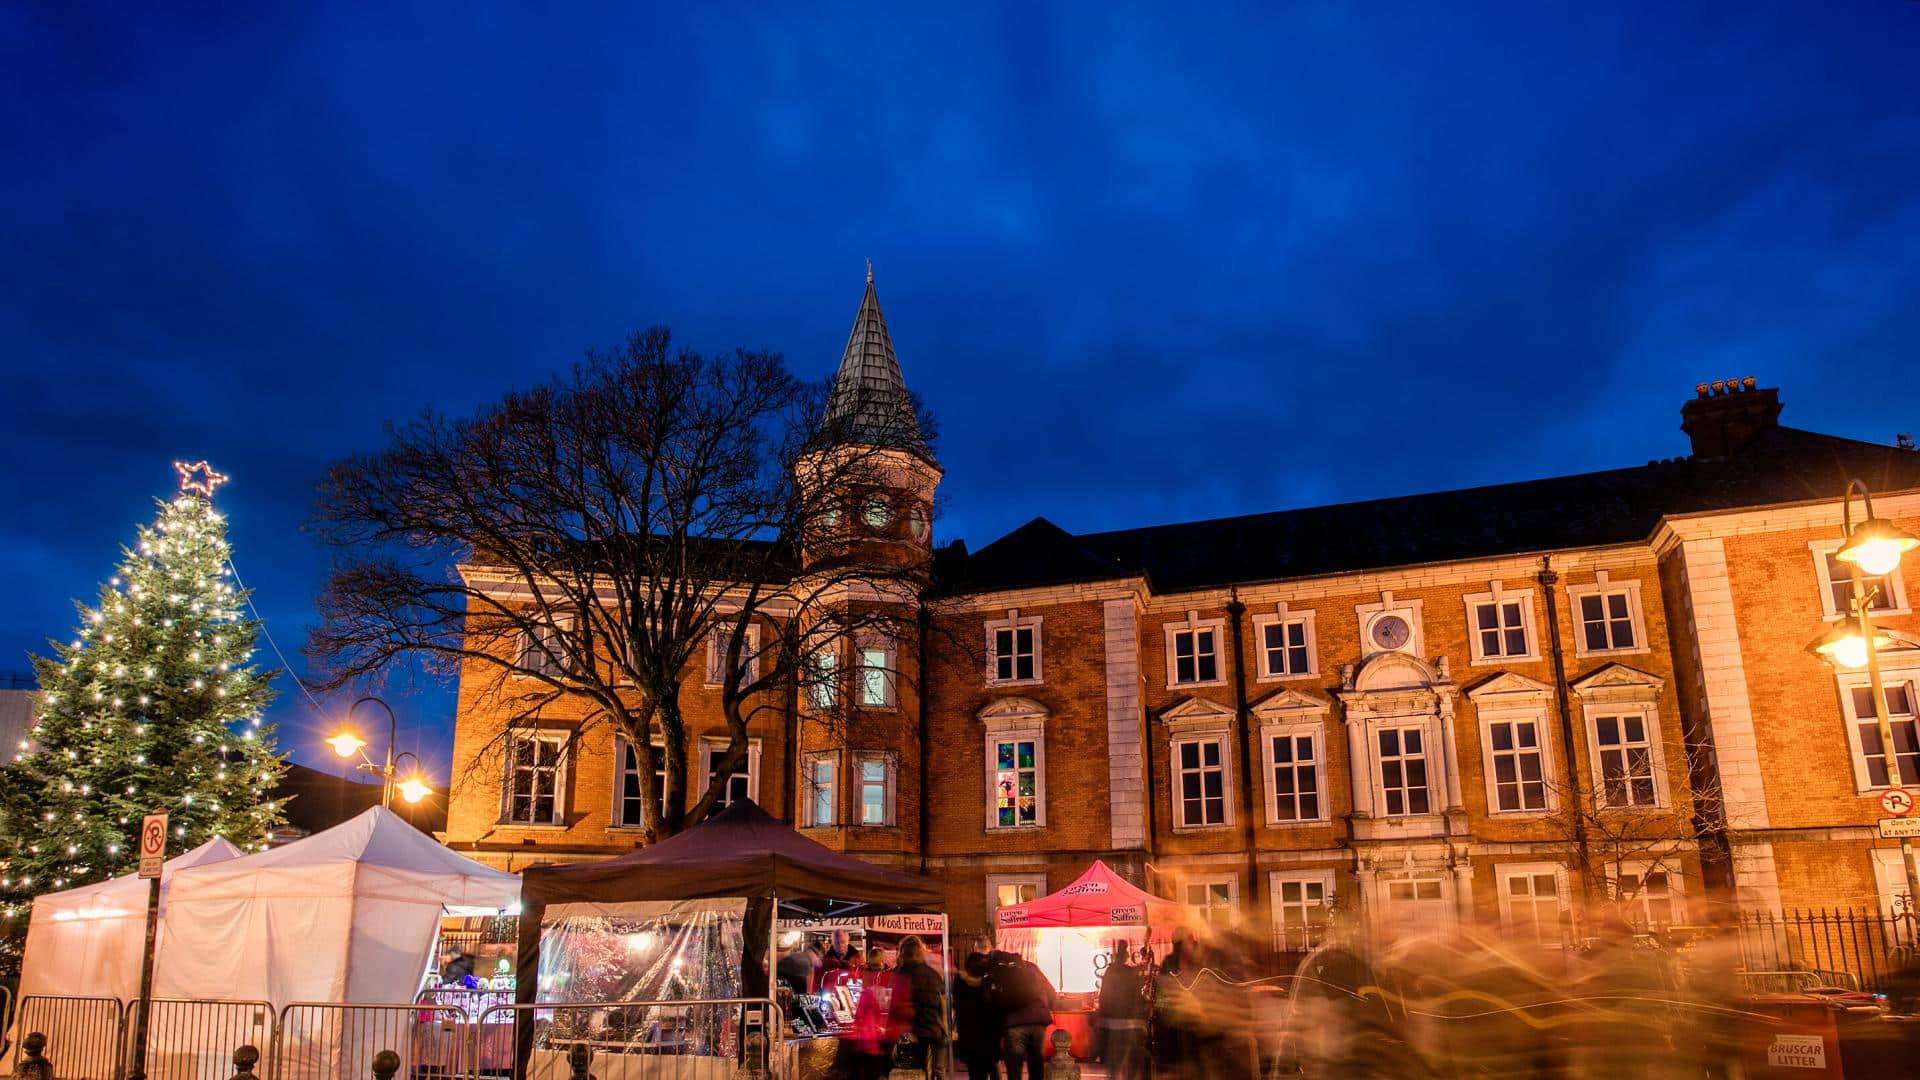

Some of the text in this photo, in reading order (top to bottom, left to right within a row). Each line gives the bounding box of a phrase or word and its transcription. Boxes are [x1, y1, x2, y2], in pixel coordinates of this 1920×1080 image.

[878, 915, 943, 930] Wood Fired Pizz
[1000, 916, 1029, 924] Saffron
[1770, 1044, 1821, 1055] BRUSCAR
[1778, 1055, 1816, 1066] LITTER
